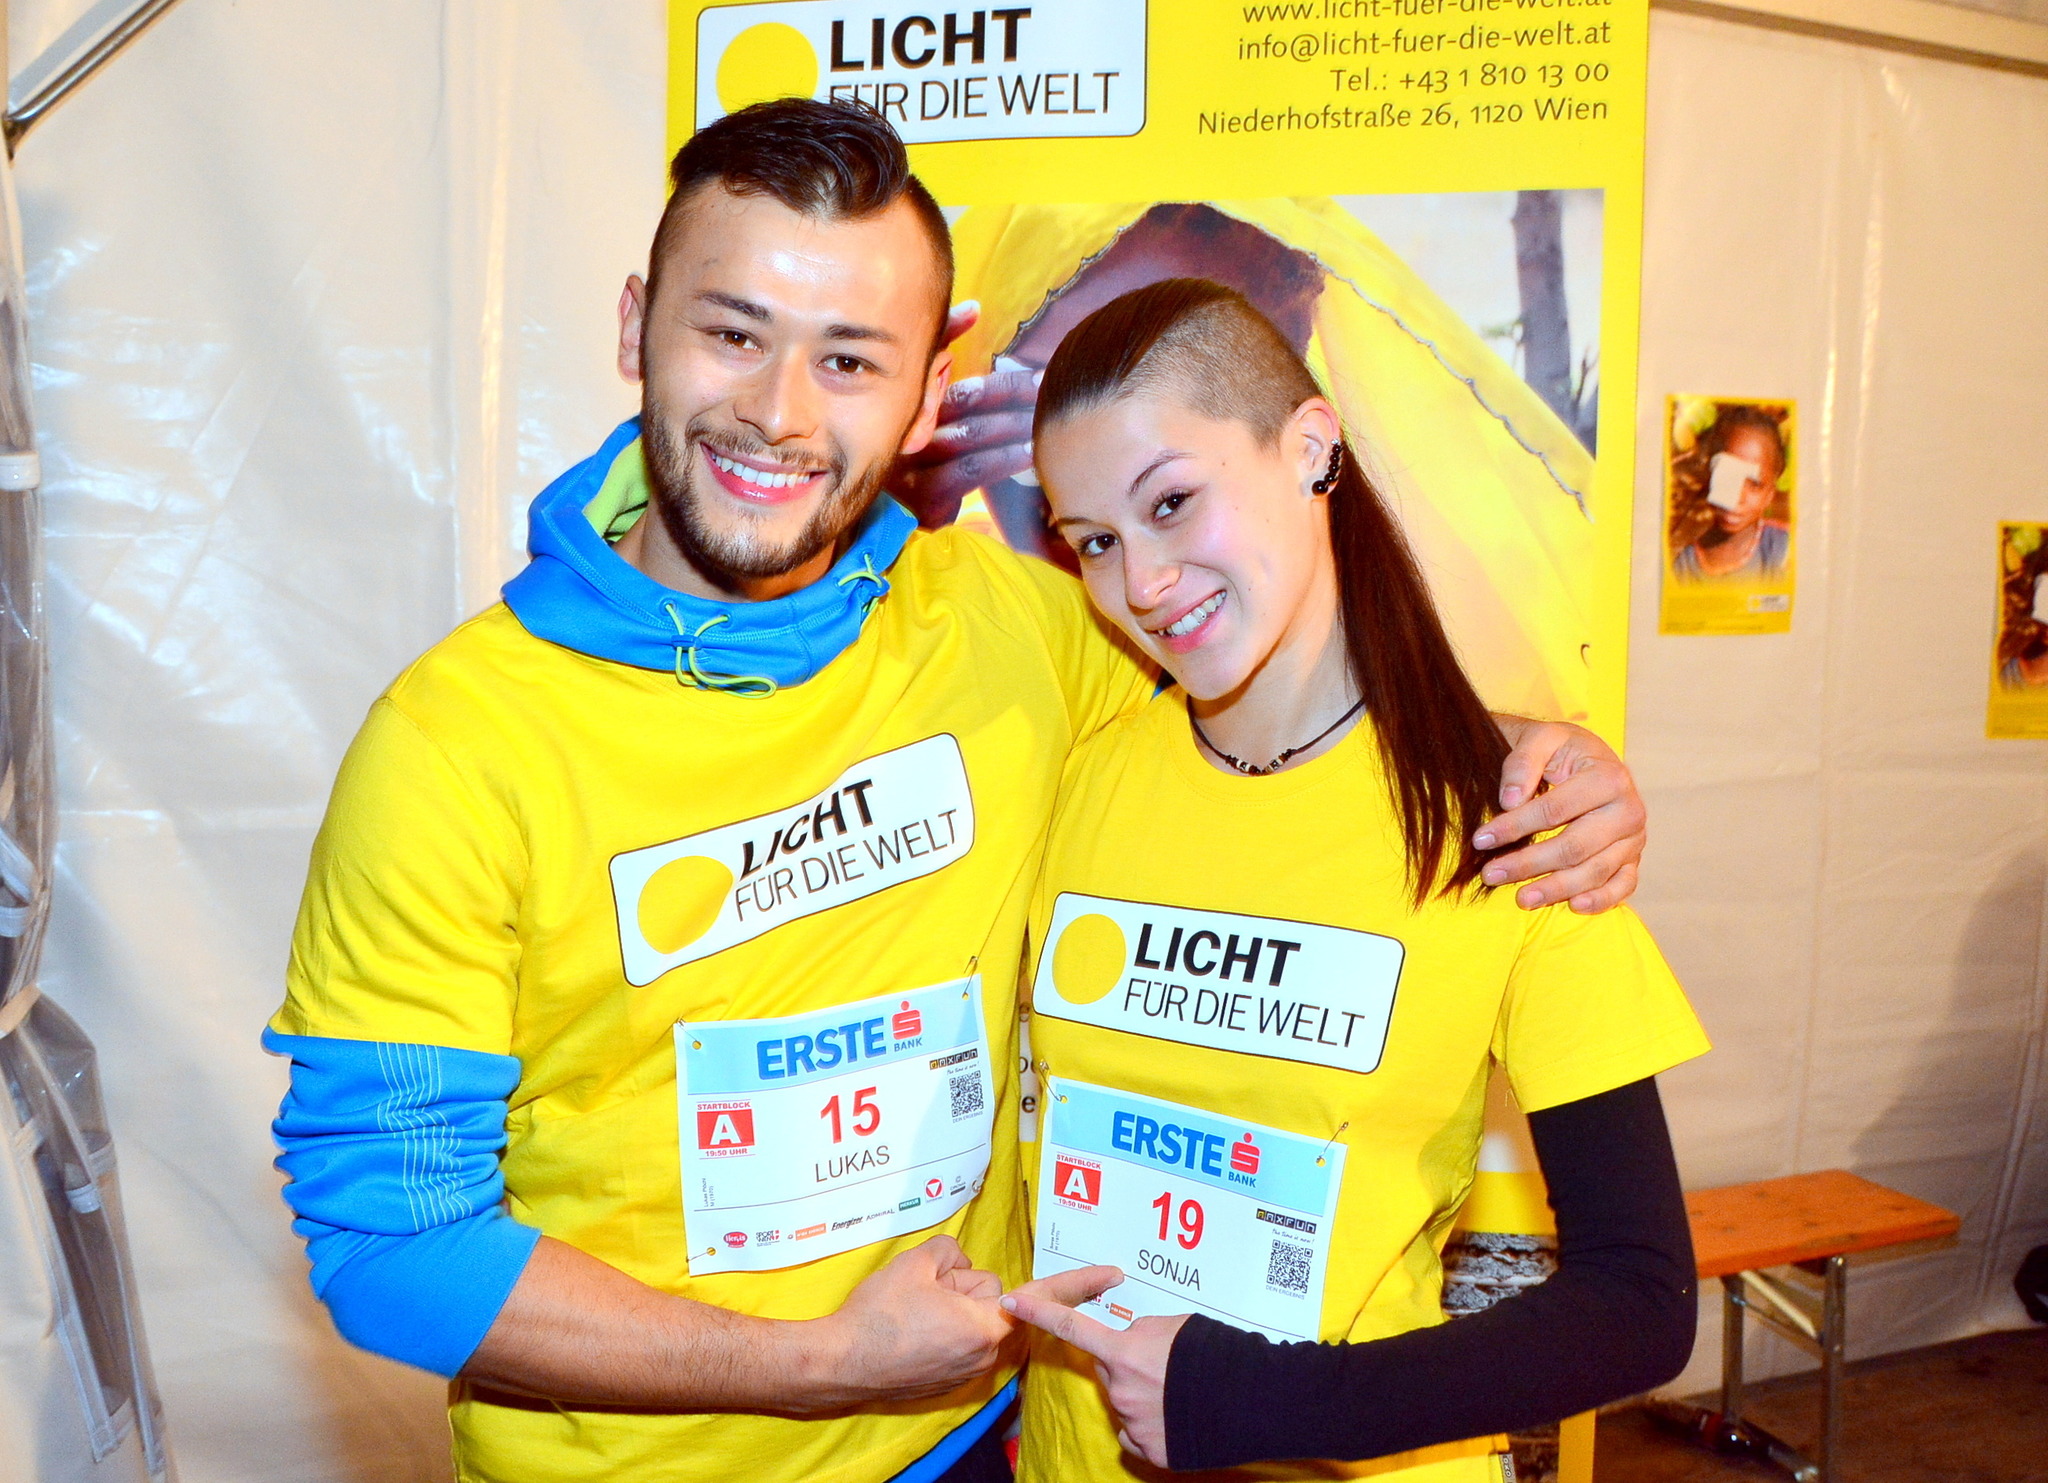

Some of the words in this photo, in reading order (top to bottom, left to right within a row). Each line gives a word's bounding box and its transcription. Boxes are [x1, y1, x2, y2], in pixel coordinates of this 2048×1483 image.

[830, 7, 1032, 73] LICHT
[1239, 20, 1611, 62] info@licht-fuer-die-welt.at
[920, 76, 988, 121] DIE
[998, 72, 1120, 118] WELT
[1330, 66, 1388, 92] Tel.:
[1399, 69, 1449, 93] +43
[1459, 69, 1469, 87] 1
[1480, 63, 1526, 87] 810
[1538, 65, 1563, 88] 13
[1198, 102, 1411, 135] Niederhofstraße
[1420, 107, 1460, 129] 26,
[1470, 104, 1523, 125] 1120
[1534, 97, 1608, 121] Wien
[739, 778, 874, 882] LICHT
[735, 867, 798, 922] FÜR
[801, 844, 865, 894] DIE
[864, 808, 957, 870] WELT
[1133, 923, 1302, 987] LICHT
[1123, 977, 1189, 1022] FÜR
[1193, 989, 1254, 1032] DIE
[1258, 996, 1366, 1048] WELT
[756, 1016, 887, 1080] ERSTE
[894, 1037, 923, 1053] BANK
[697, 1101, 751, 1111] STARTBLOCK
[820, 1086, 881, 1144] 15
[709, 1113, 743, 1146] A
[1111, 1110, 1226, 1178] ERSTE
[705, 1149, 728, 1157] 19:50
[729, 1148, 748, 1156] UHR
[815, 1145, 891, 1183] LUKAS
[1056, 1154, 1102, 1170] STARTBLOCK
[1063, 1168, 1090, 1201] A
[1228, 1171, 1257, 1188] BANK
[831, 1216, 864, 1231] Energizer
[866, 1208, 896, 1221] ADMIRAL
[1058, 1198, 1076, 1208] 19:50
[1077, 1203, 1092, 1212] UHR
[1152, 1191, 1205, 1250] 19
[1137, 1249, 1202, 1291] SONJA
